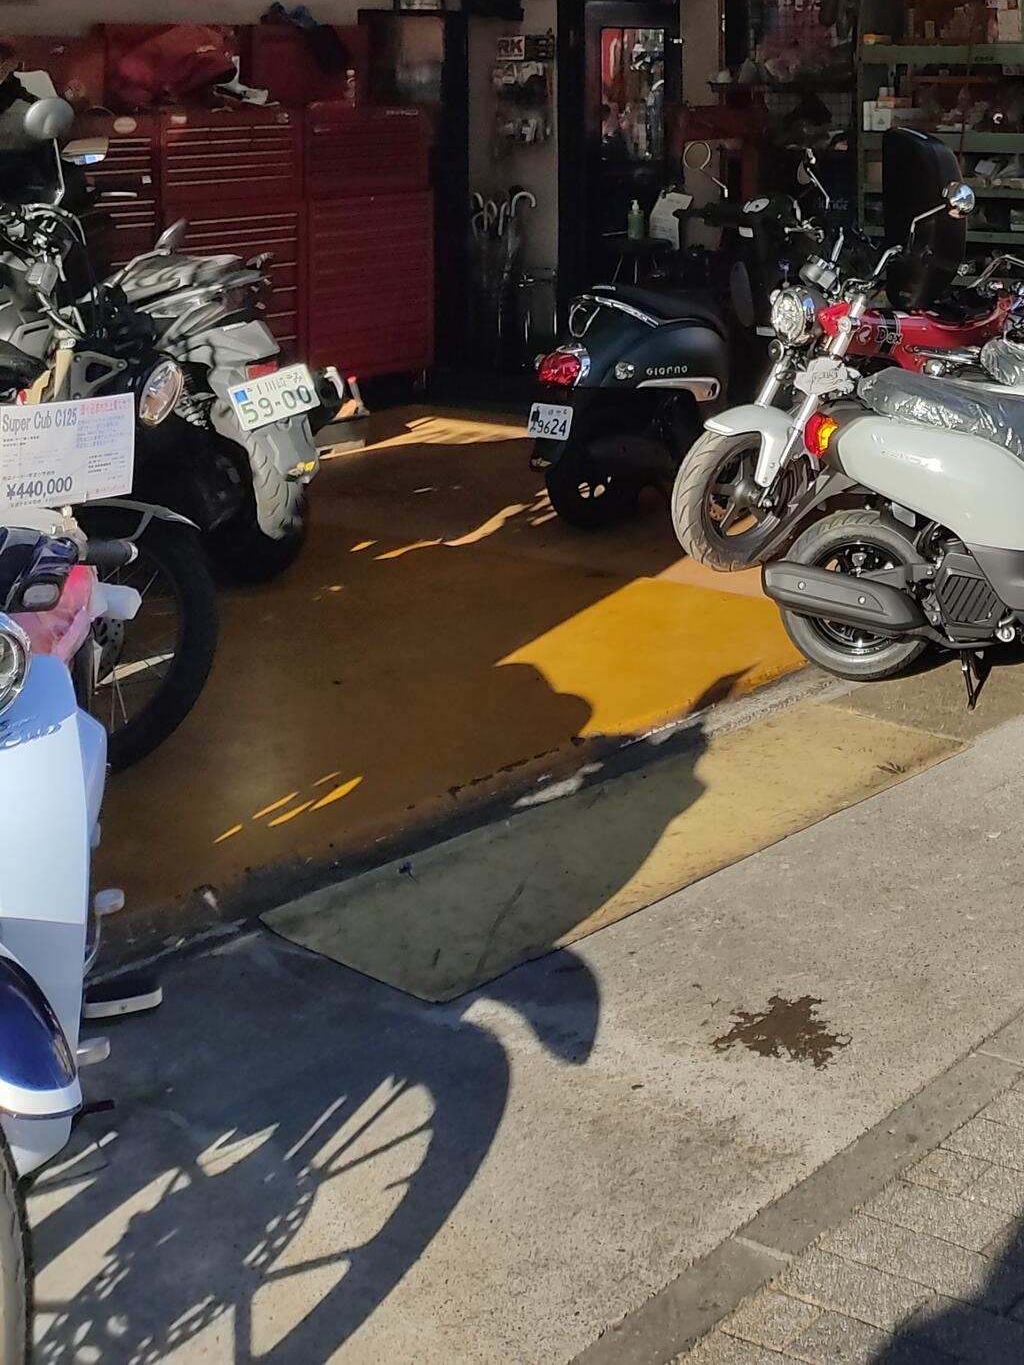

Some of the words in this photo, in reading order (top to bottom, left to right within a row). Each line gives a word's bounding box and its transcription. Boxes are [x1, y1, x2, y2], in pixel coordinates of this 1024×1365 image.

[876, 326, 903, 345] Dax
[240, 385, 312, 424] 59-00
[2, 413, 31, 435] Super
[33, 410, 52, 430] Cub
[54, 407, 78, 427] C125
[6, 475, 73, 500] ¥440,000
